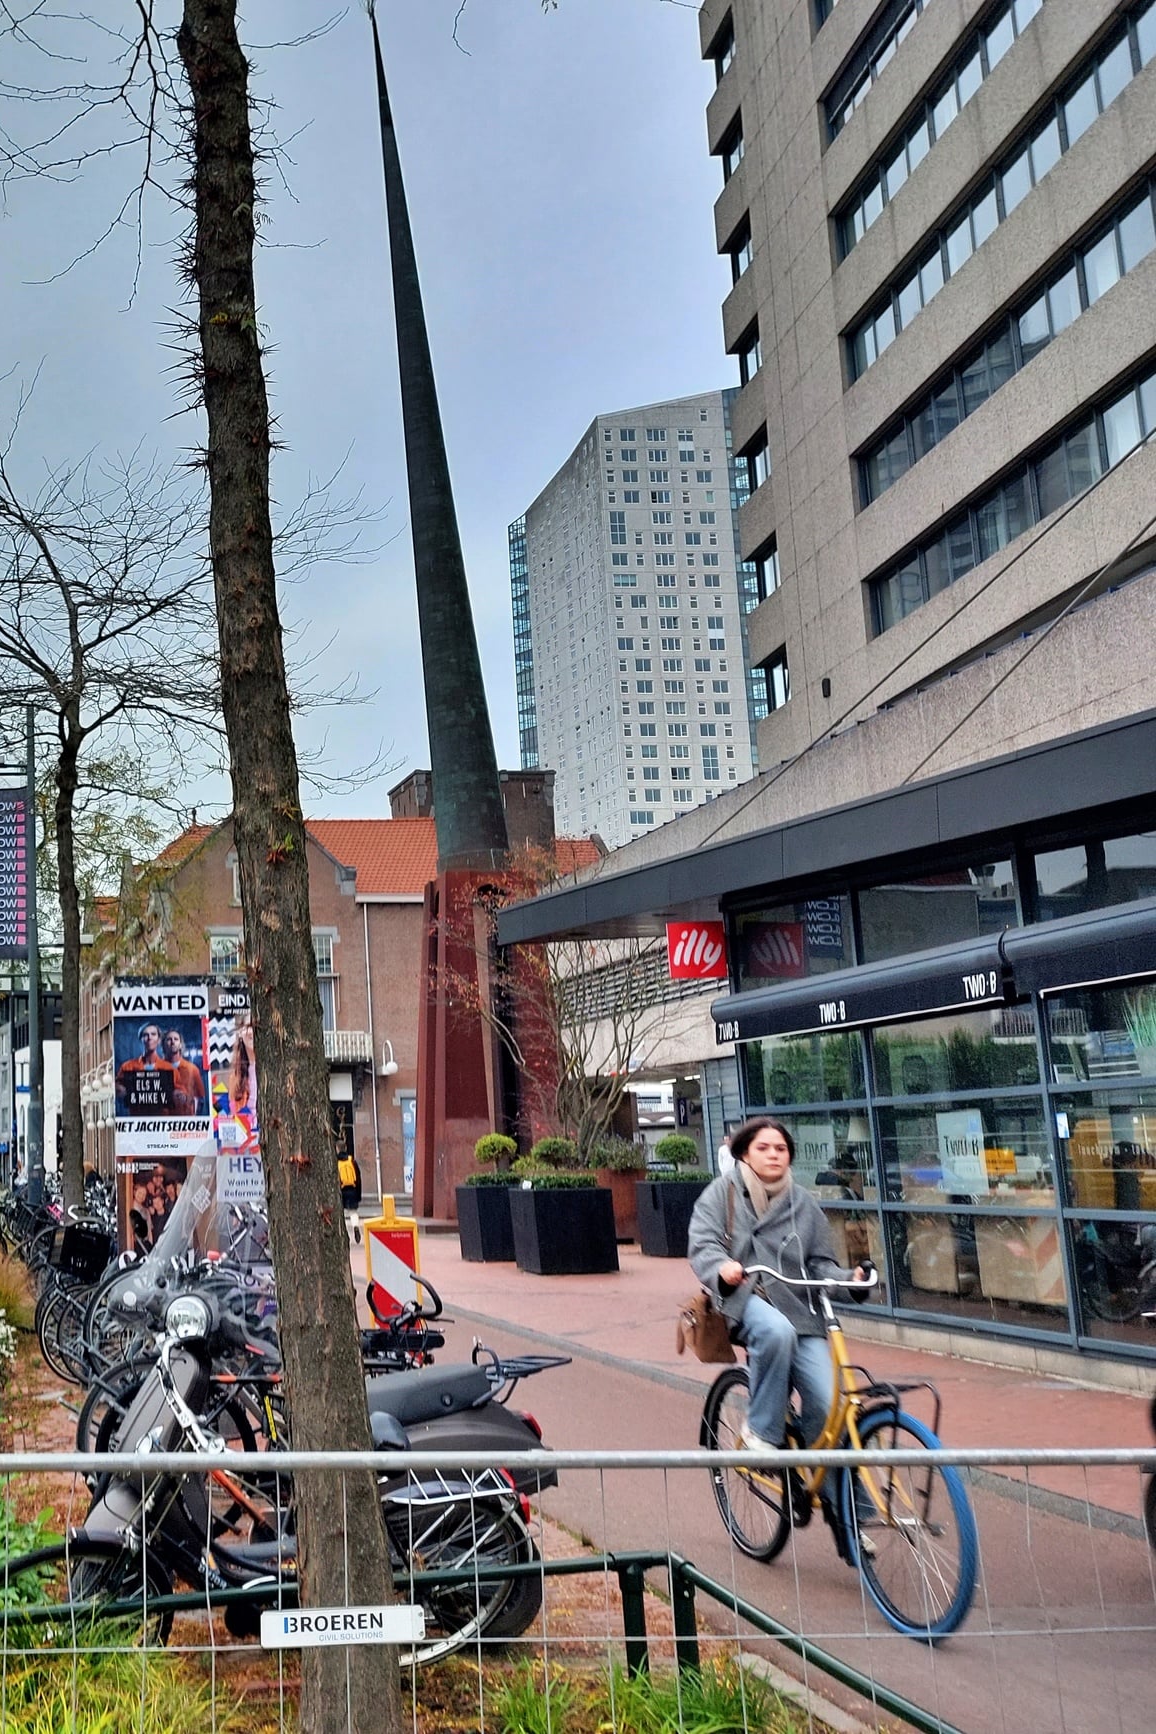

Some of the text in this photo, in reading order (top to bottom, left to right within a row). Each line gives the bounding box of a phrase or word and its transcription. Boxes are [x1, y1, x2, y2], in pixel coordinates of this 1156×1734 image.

[673, 929, 722, 974] illy
[112, 994, 206, 1012] WANTED
[136, 1079, 163, 1091] ELS W.
[130, 1092, 168, 1104] & MIKE V.
[114, 1120, 210, 1133] HET JACHTSEIZOEN
[228, 1179, 249, 1187] Want
[284, 1612, 383, 1634] BROEREN
[318, 1631, 384, 1642] CIVIL SOLUTIONS
